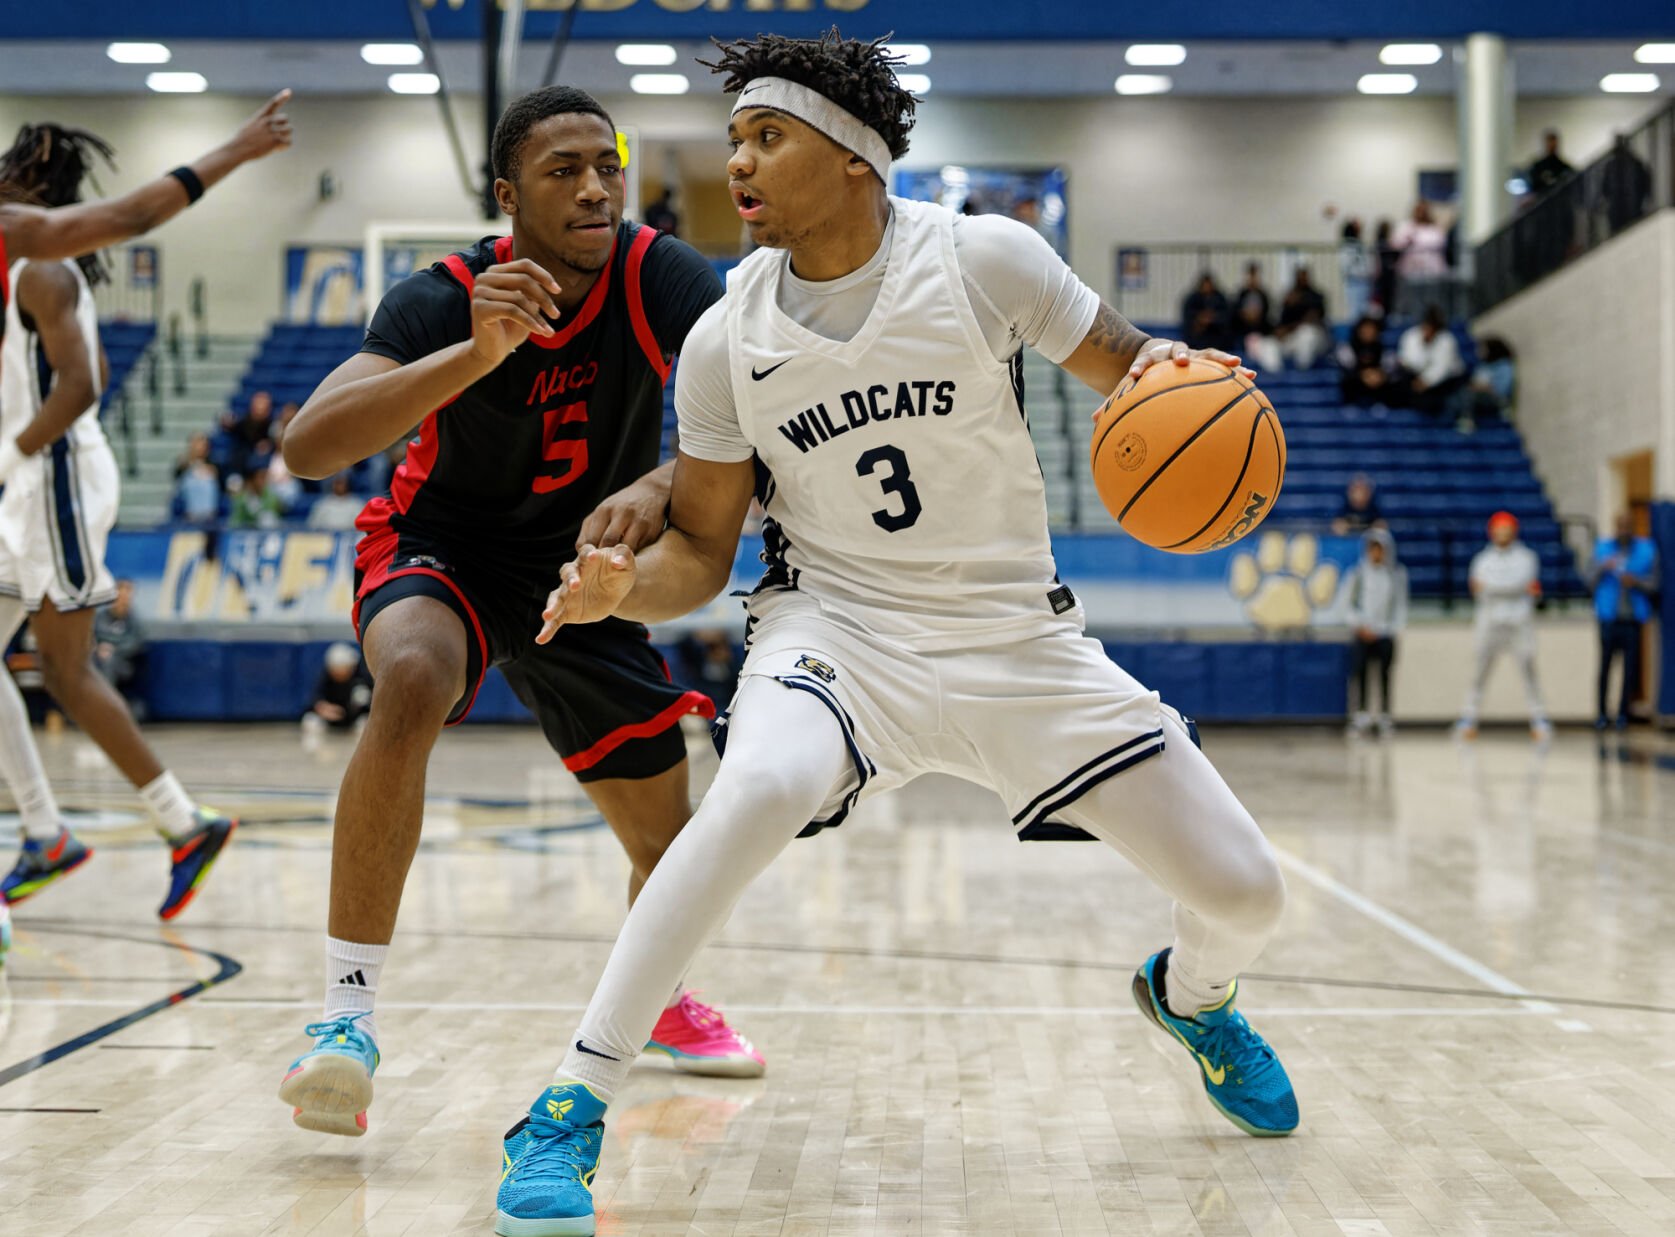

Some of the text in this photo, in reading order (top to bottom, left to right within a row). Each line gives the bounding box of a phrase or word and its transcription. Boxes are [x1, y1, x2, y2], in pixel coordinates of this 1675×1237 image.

[532, 400, 589, 494] 5
[777, 380, 956, 454] WILDCATS
[855, 444, 922, 533] 3
[1211, 492, 1267, 548] NCA
